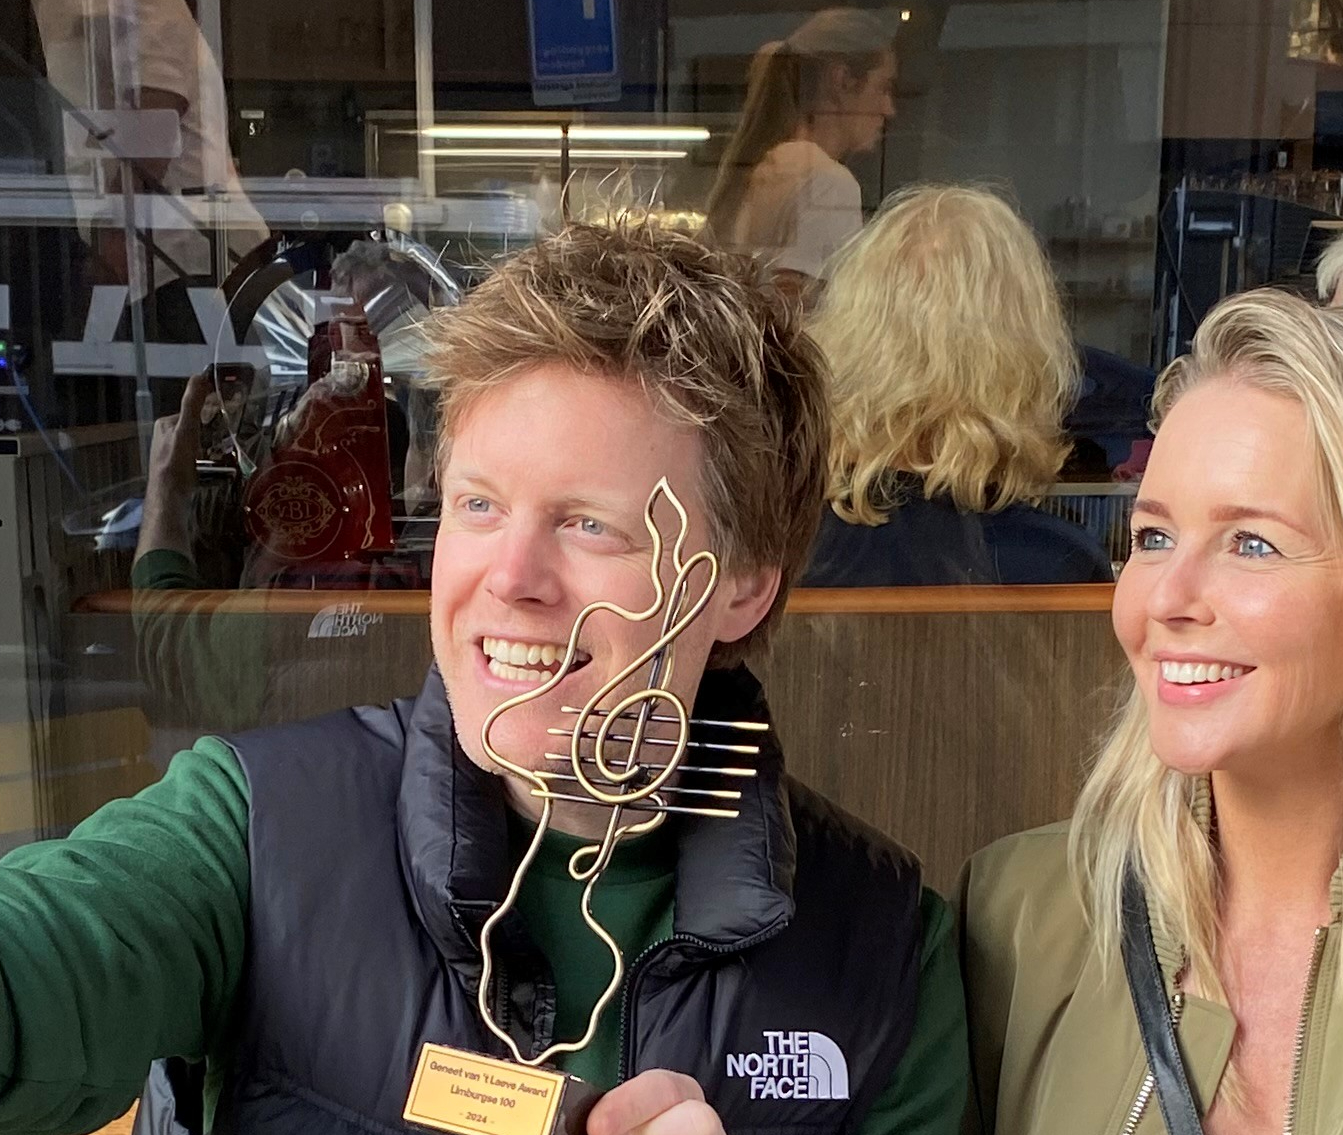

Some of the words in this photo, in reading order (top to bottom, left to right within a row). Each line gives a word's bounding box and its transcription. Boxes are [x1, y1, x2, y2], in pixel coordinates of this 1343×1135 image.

[763, 1031, 809, 1054] THE
[726, 1053, 809, 1077] NORTH
[430, 1060, 463, 1078] Geneet
[464, 1071, 480, 1082] van
[490, 1077, 517, 1090] Laeve
[517, 1083, 549, 1098] Award
[750, 1076, 809, 1099] FACE
[450, 1084, 498, 1104] Limburgse
[499, 1097, 516, 1108] 100
[465, 1111, 488, 1124] 2024
